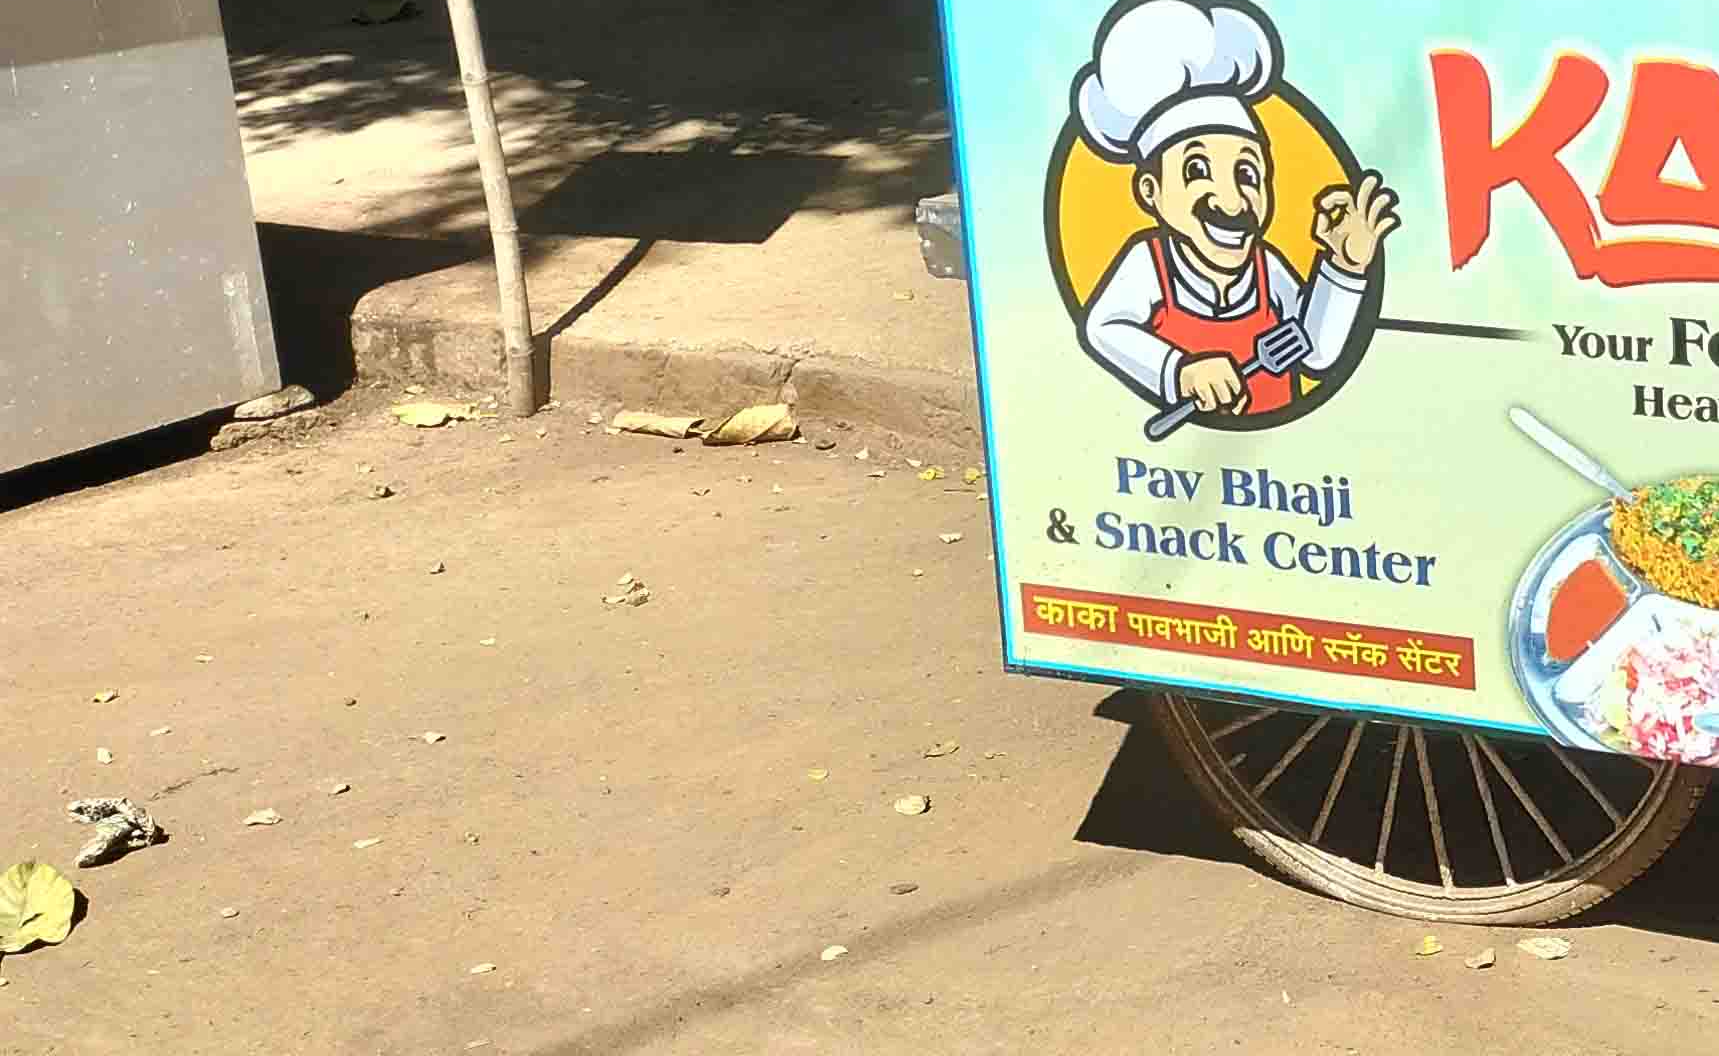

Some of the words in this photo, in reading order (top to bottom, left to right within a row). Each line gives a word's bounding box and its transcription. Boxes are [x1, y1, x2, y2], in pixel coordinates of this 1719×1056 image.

[1552, 323, 1654, 364] Your
[1115, 457, 1204, 502] Pav
[1221, 467, 1354, 526] Bhaji
[1046, 507, 1080, 545] &
[1095, 511, 1249, 565] Snack
[1263, 531, 1438, 587] Center
[1033, 594, 1118, 633] काका
[1127, 610, 1238, 649] पावभाजी
[1247, 624, 1315, 660] आणि
[1322, 631, 1388, 668] स्नॅक
[1396, 637, 1463, 677] सेंटर
